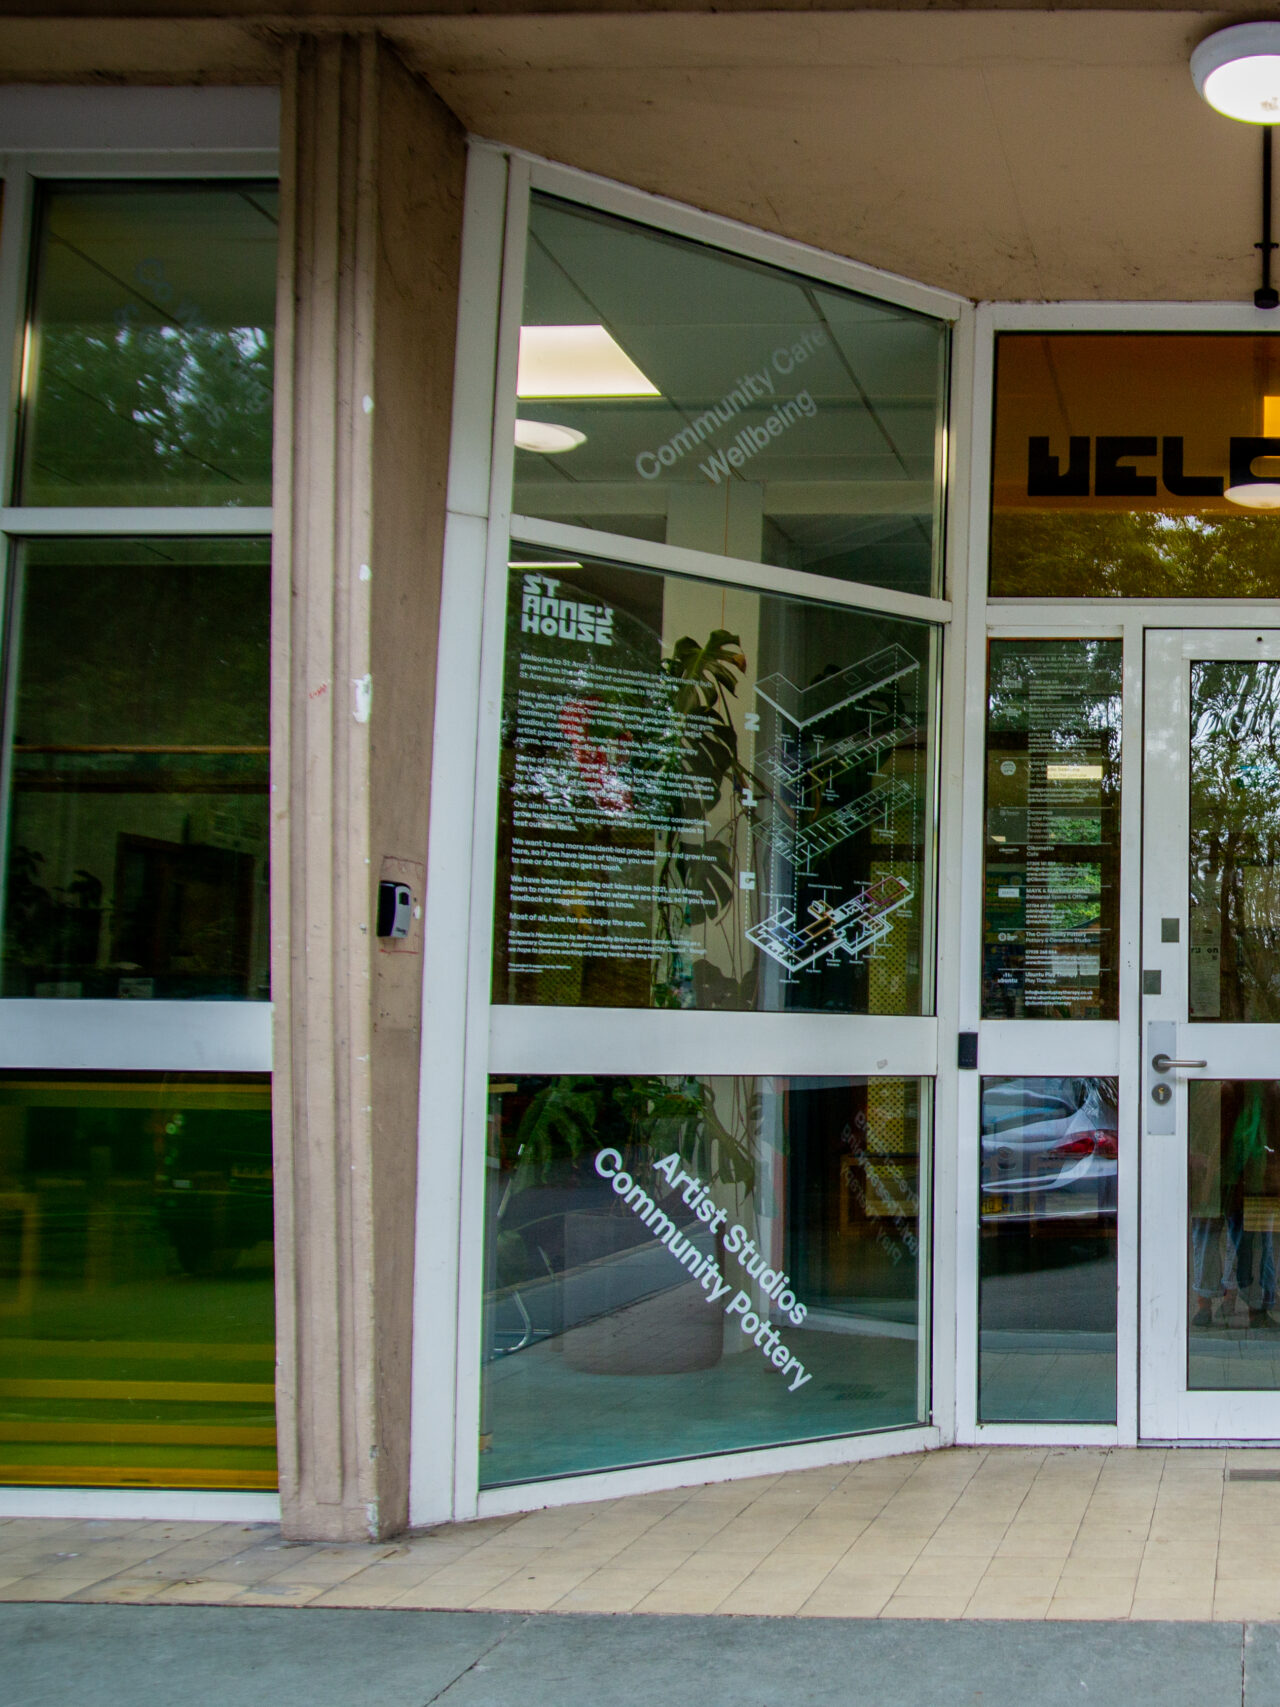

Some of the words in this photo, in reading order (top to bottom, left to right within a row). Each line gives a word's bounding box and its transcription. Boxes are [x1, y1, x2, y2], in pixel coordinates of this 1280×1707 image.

[635, 367, 775, 480] Community
[699, 389, 818, 485] Wellbeing
[522, 573, 560, 598] ST
[521, 592, 613, 626] ANNE'S
[520, 612, 613, 646] HOUSE
[519, 663, 542, 672] grown
[543, 665, 559, 674] from
[518, 689, 536, 698] Here
[744, 712, 760, 731] 2
[513, 800, 527, 808] Our
[742, 788, 758, 807] 1
[511, 846, 530, 855] here,
[560, 850, 577, 858] have
[577, 852, 596, 860] ideas
[605, 854, 626, 863] things
[640, 857, 657, 865] want
[524, 839, 542, 847] want
[584, 844, 625, 853] resident-led
[625, 847, 653, 857] projects
[553, 859, 569, 867] then
[580, 861, 592, 870] get
[559, 878, 575, 886] here
[575, 879, 600, 889] testing
[613, 882, 632, 890] ideas
[681, 887, 702, 896] always
[739, 872, 756, 890] G
[509, 893, 542, 902] feedback
[552, 896, 595, 907] suggestions
[510, 884, 527, 892] keen
[537, 886, 561, 894] reflect
[612, 891, 628, 899] what
[509, 912, 528, 920] Most
[592, 917, 610, 926] enjoy
[653, 1152, 727, 1234] Artist
[723, 1224, 807, 1325] Studios
[595, 1148, 732, 1303] Community
[725, 1291, 813, 1392] Pottery
